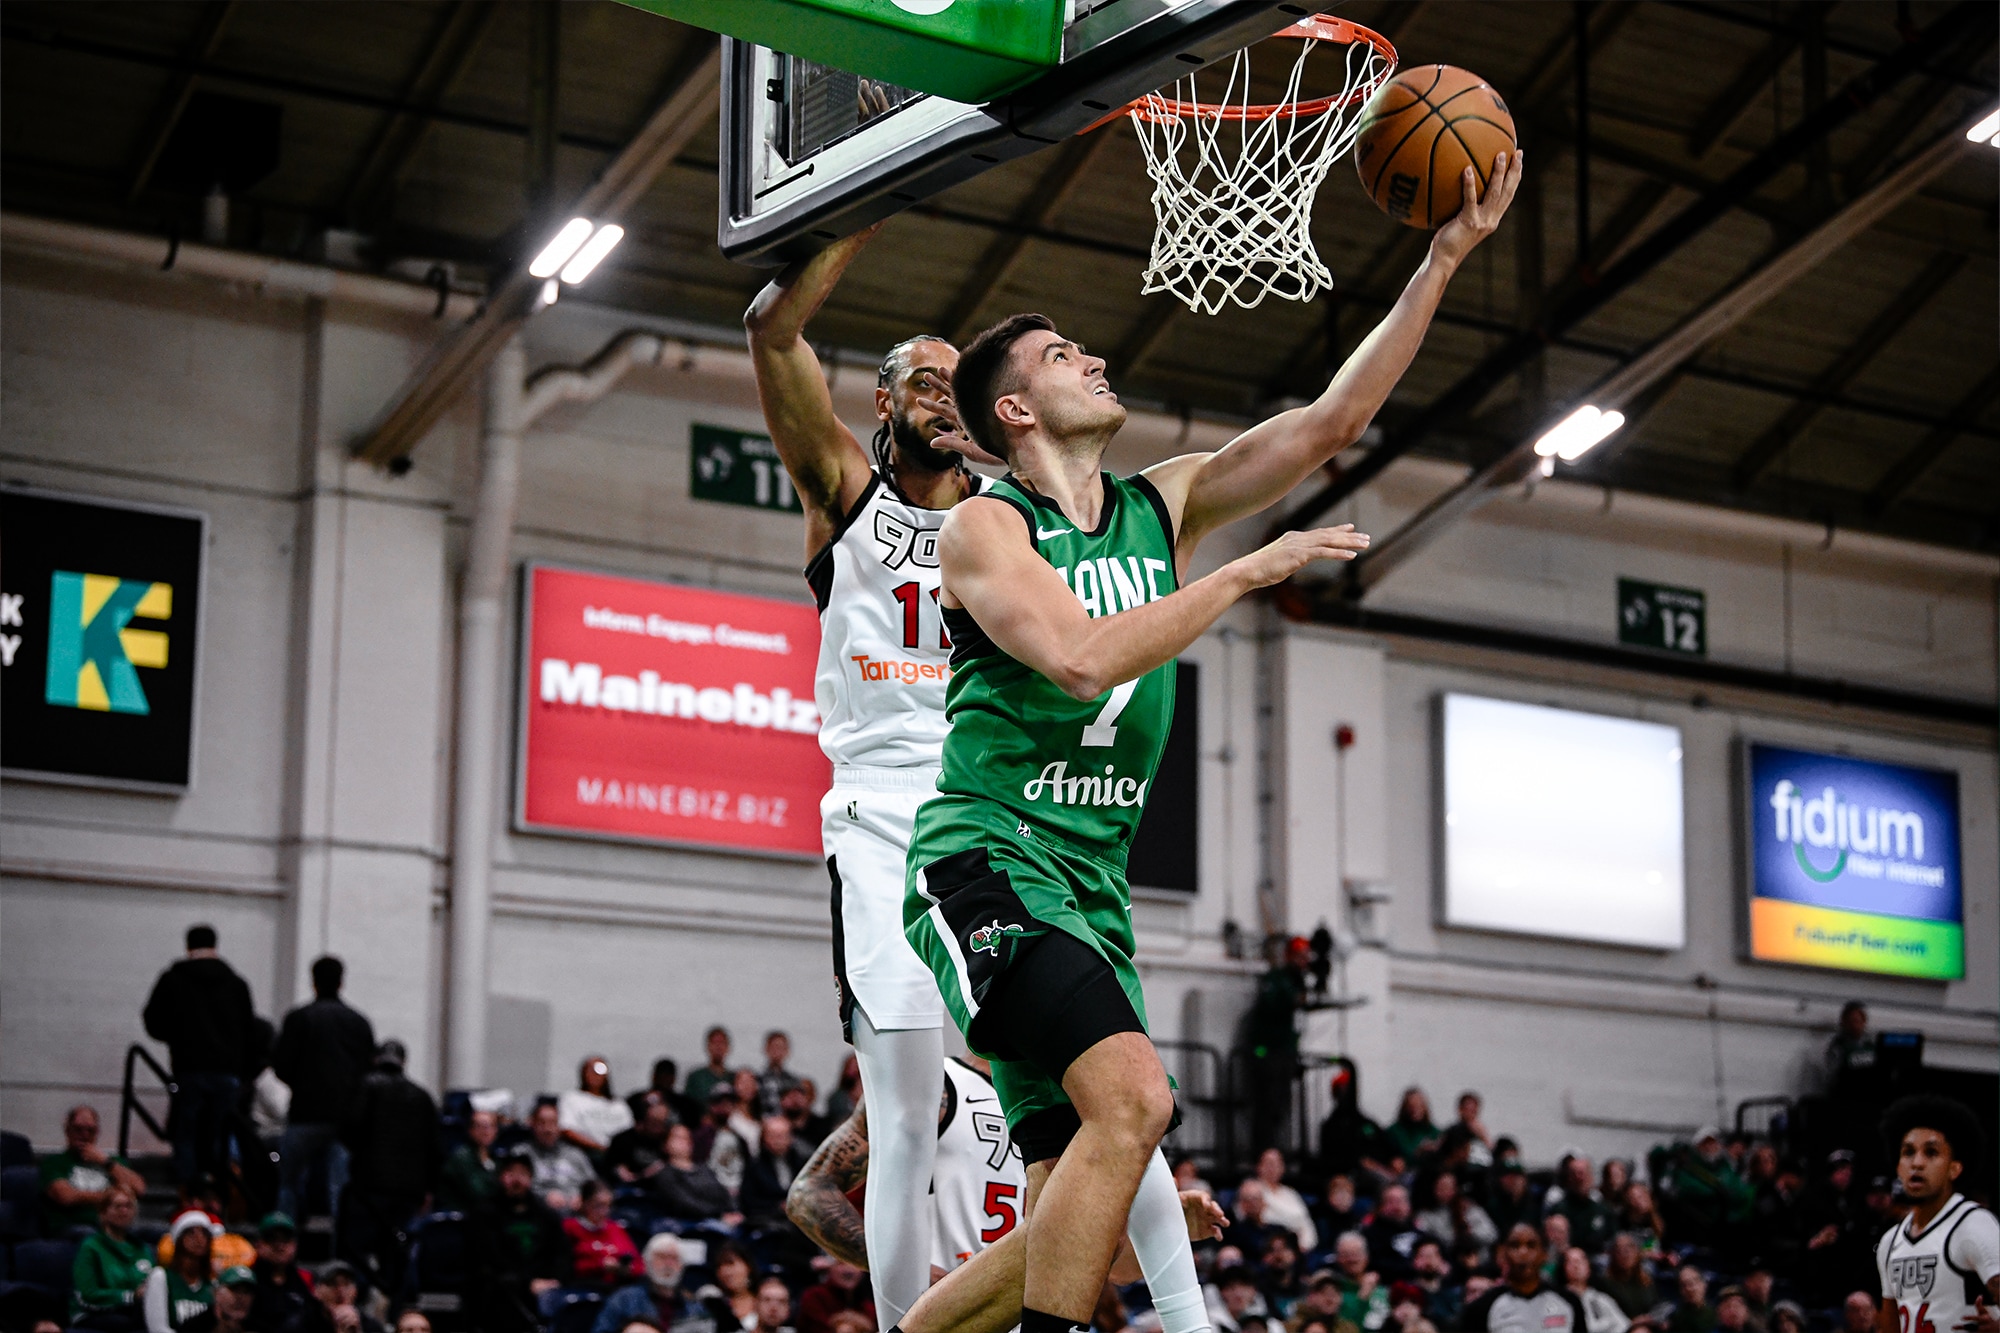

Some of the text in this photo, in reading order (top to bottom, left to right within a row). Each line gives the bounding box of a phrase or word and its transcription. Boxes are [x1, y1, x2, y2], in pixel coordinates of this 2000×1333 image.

[874, 509, 940, 571] 90
[1055, 556, 1167, 619] AINE
[1660, 608, 1699, 652] 12
[540, 657, 822, 735] Mainebiz
[851, 655, 955, 685] Tanger
[1770, 779, 1926, 861] fidium
